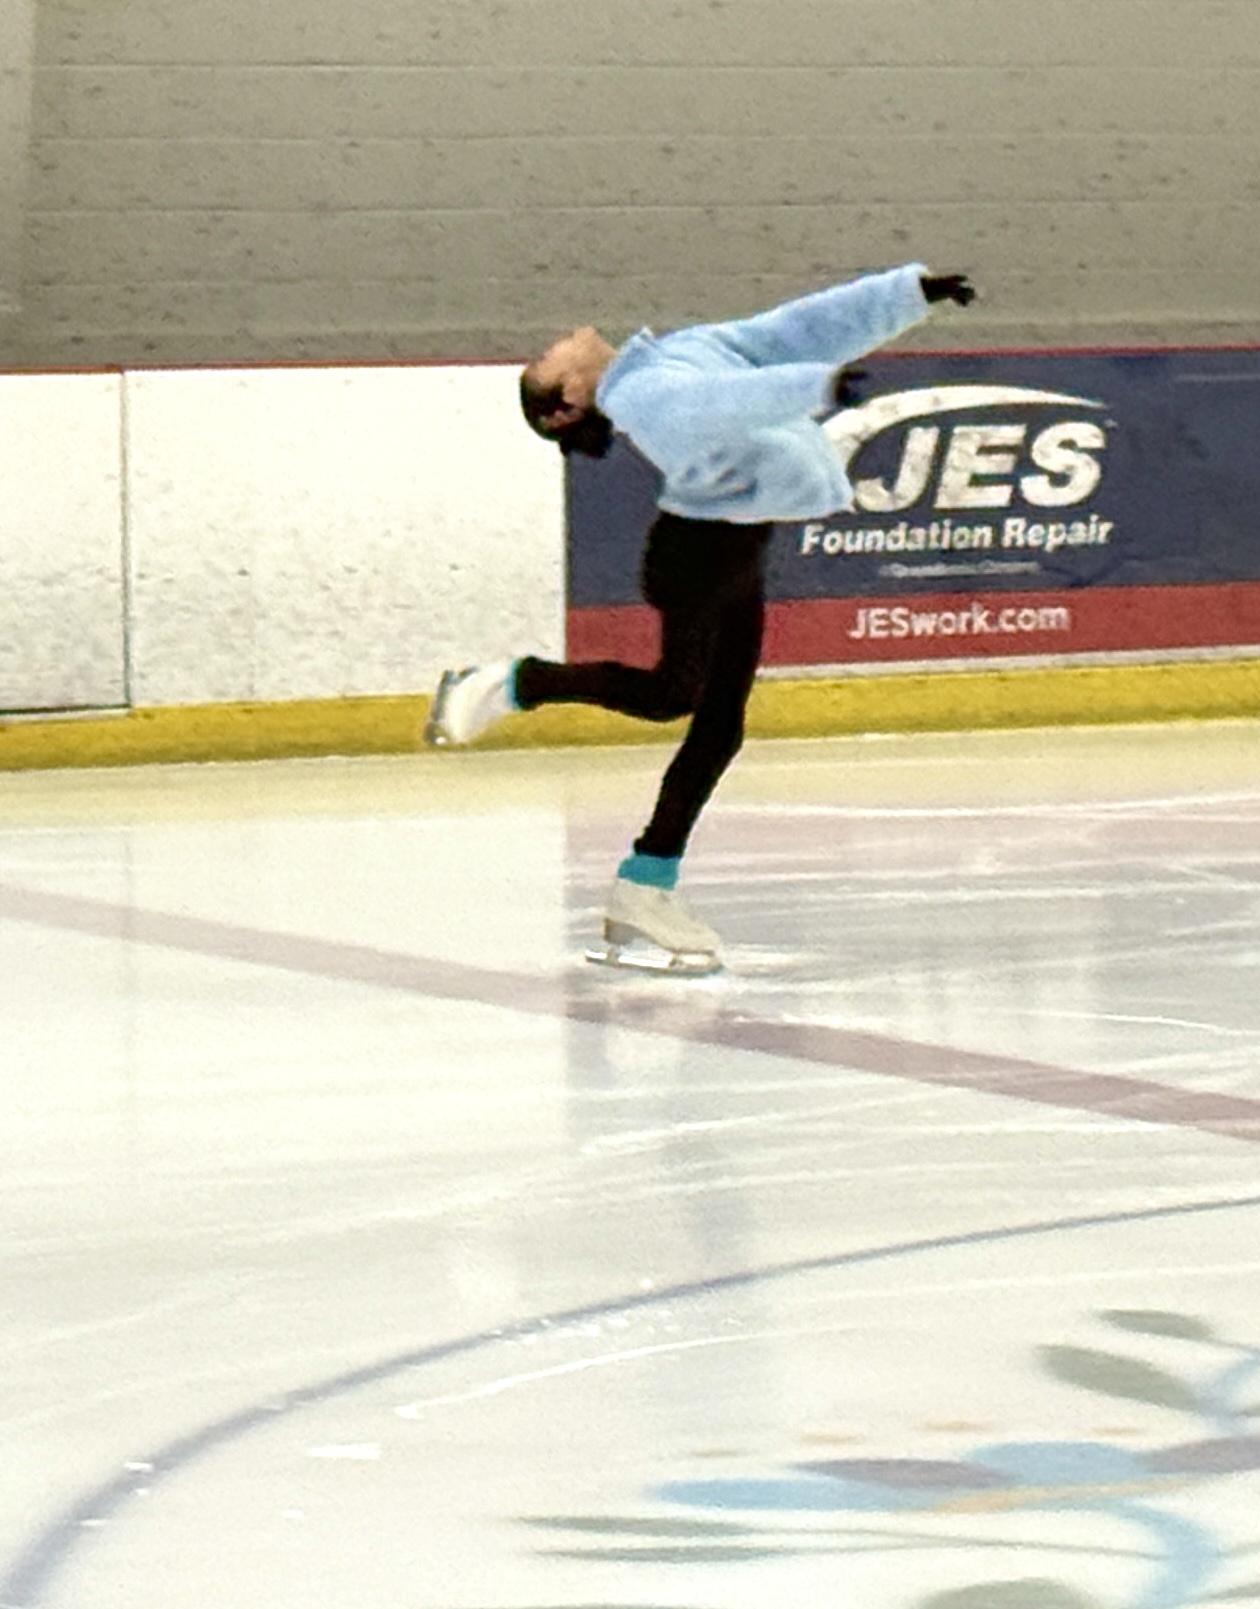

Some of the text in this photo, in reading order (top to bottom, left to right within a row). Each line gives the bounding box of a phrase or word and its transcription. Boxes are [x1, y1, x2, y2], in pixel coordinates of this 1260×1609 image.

[853, 421, 1106, 512] JES
[801, 514, 1114, 555] Foundation Repair
[847, 602, 1071, 639] JESwork.com
